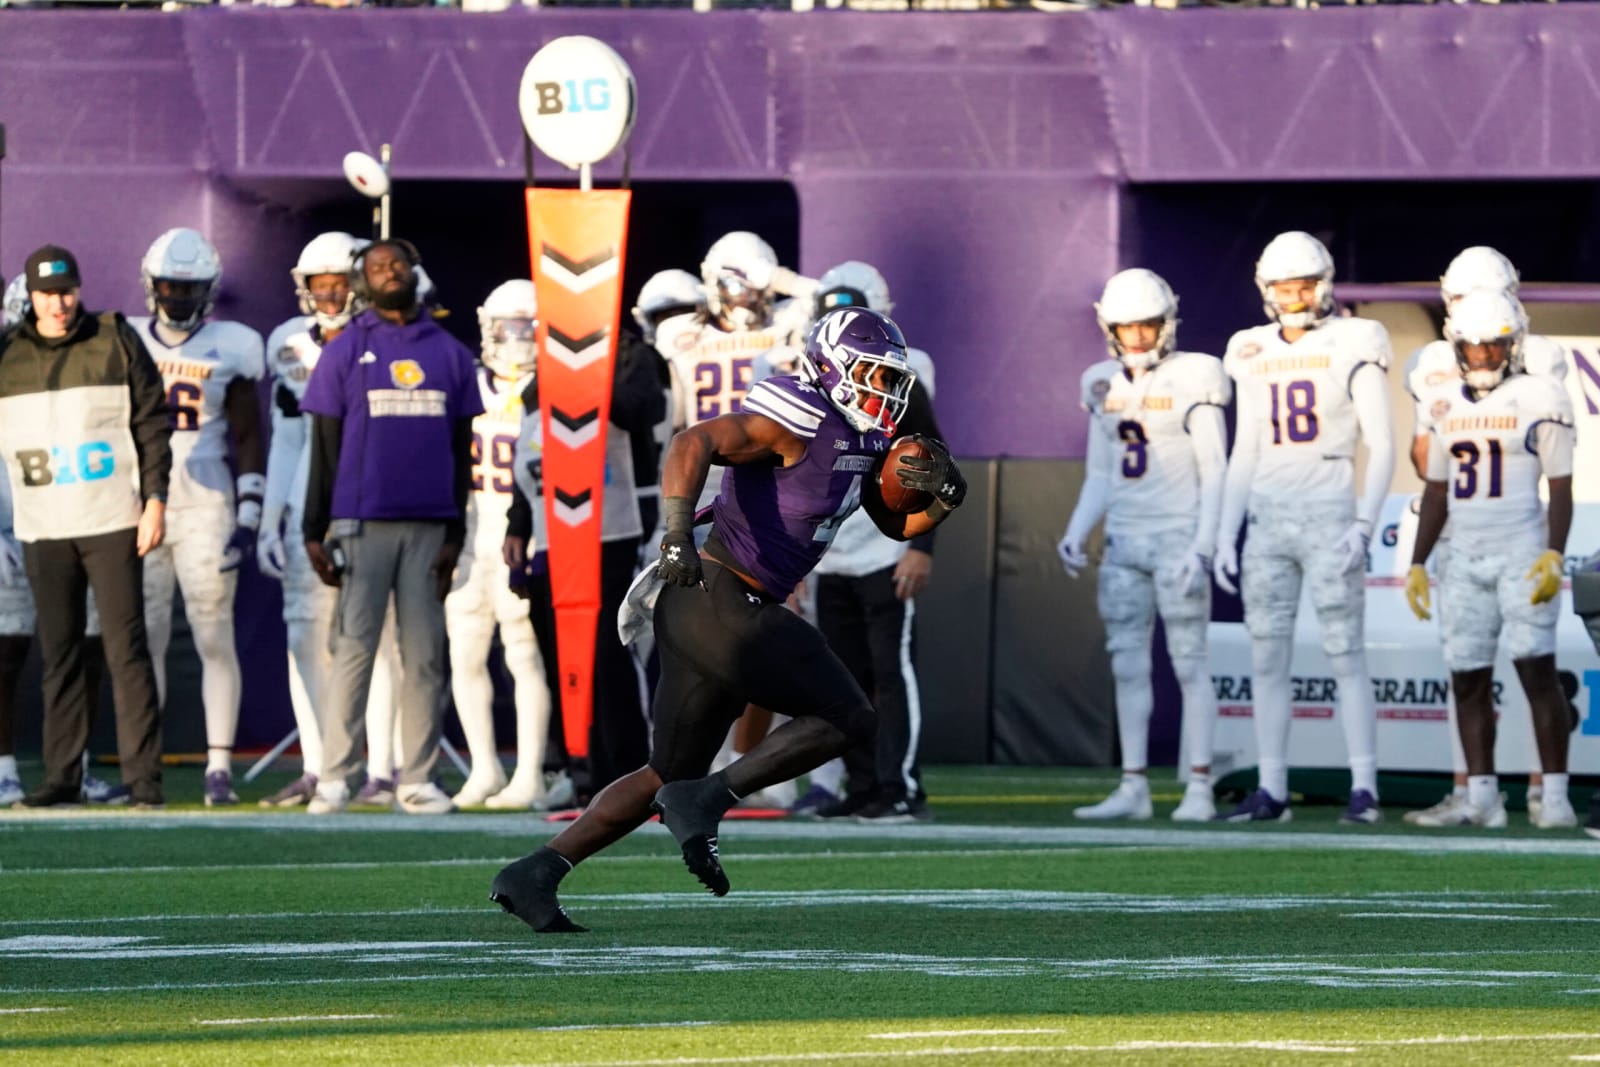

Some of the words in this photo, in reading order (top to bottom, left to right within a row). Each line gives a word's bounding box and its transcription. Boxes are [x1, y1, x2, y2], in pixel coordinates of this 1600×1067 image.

[694, 356, 754, 421] 25
[1269, 379, 1319, 445] 18
[1117, 419, 1149, 479] 3
[1449, 437, 1504, 500] 31
